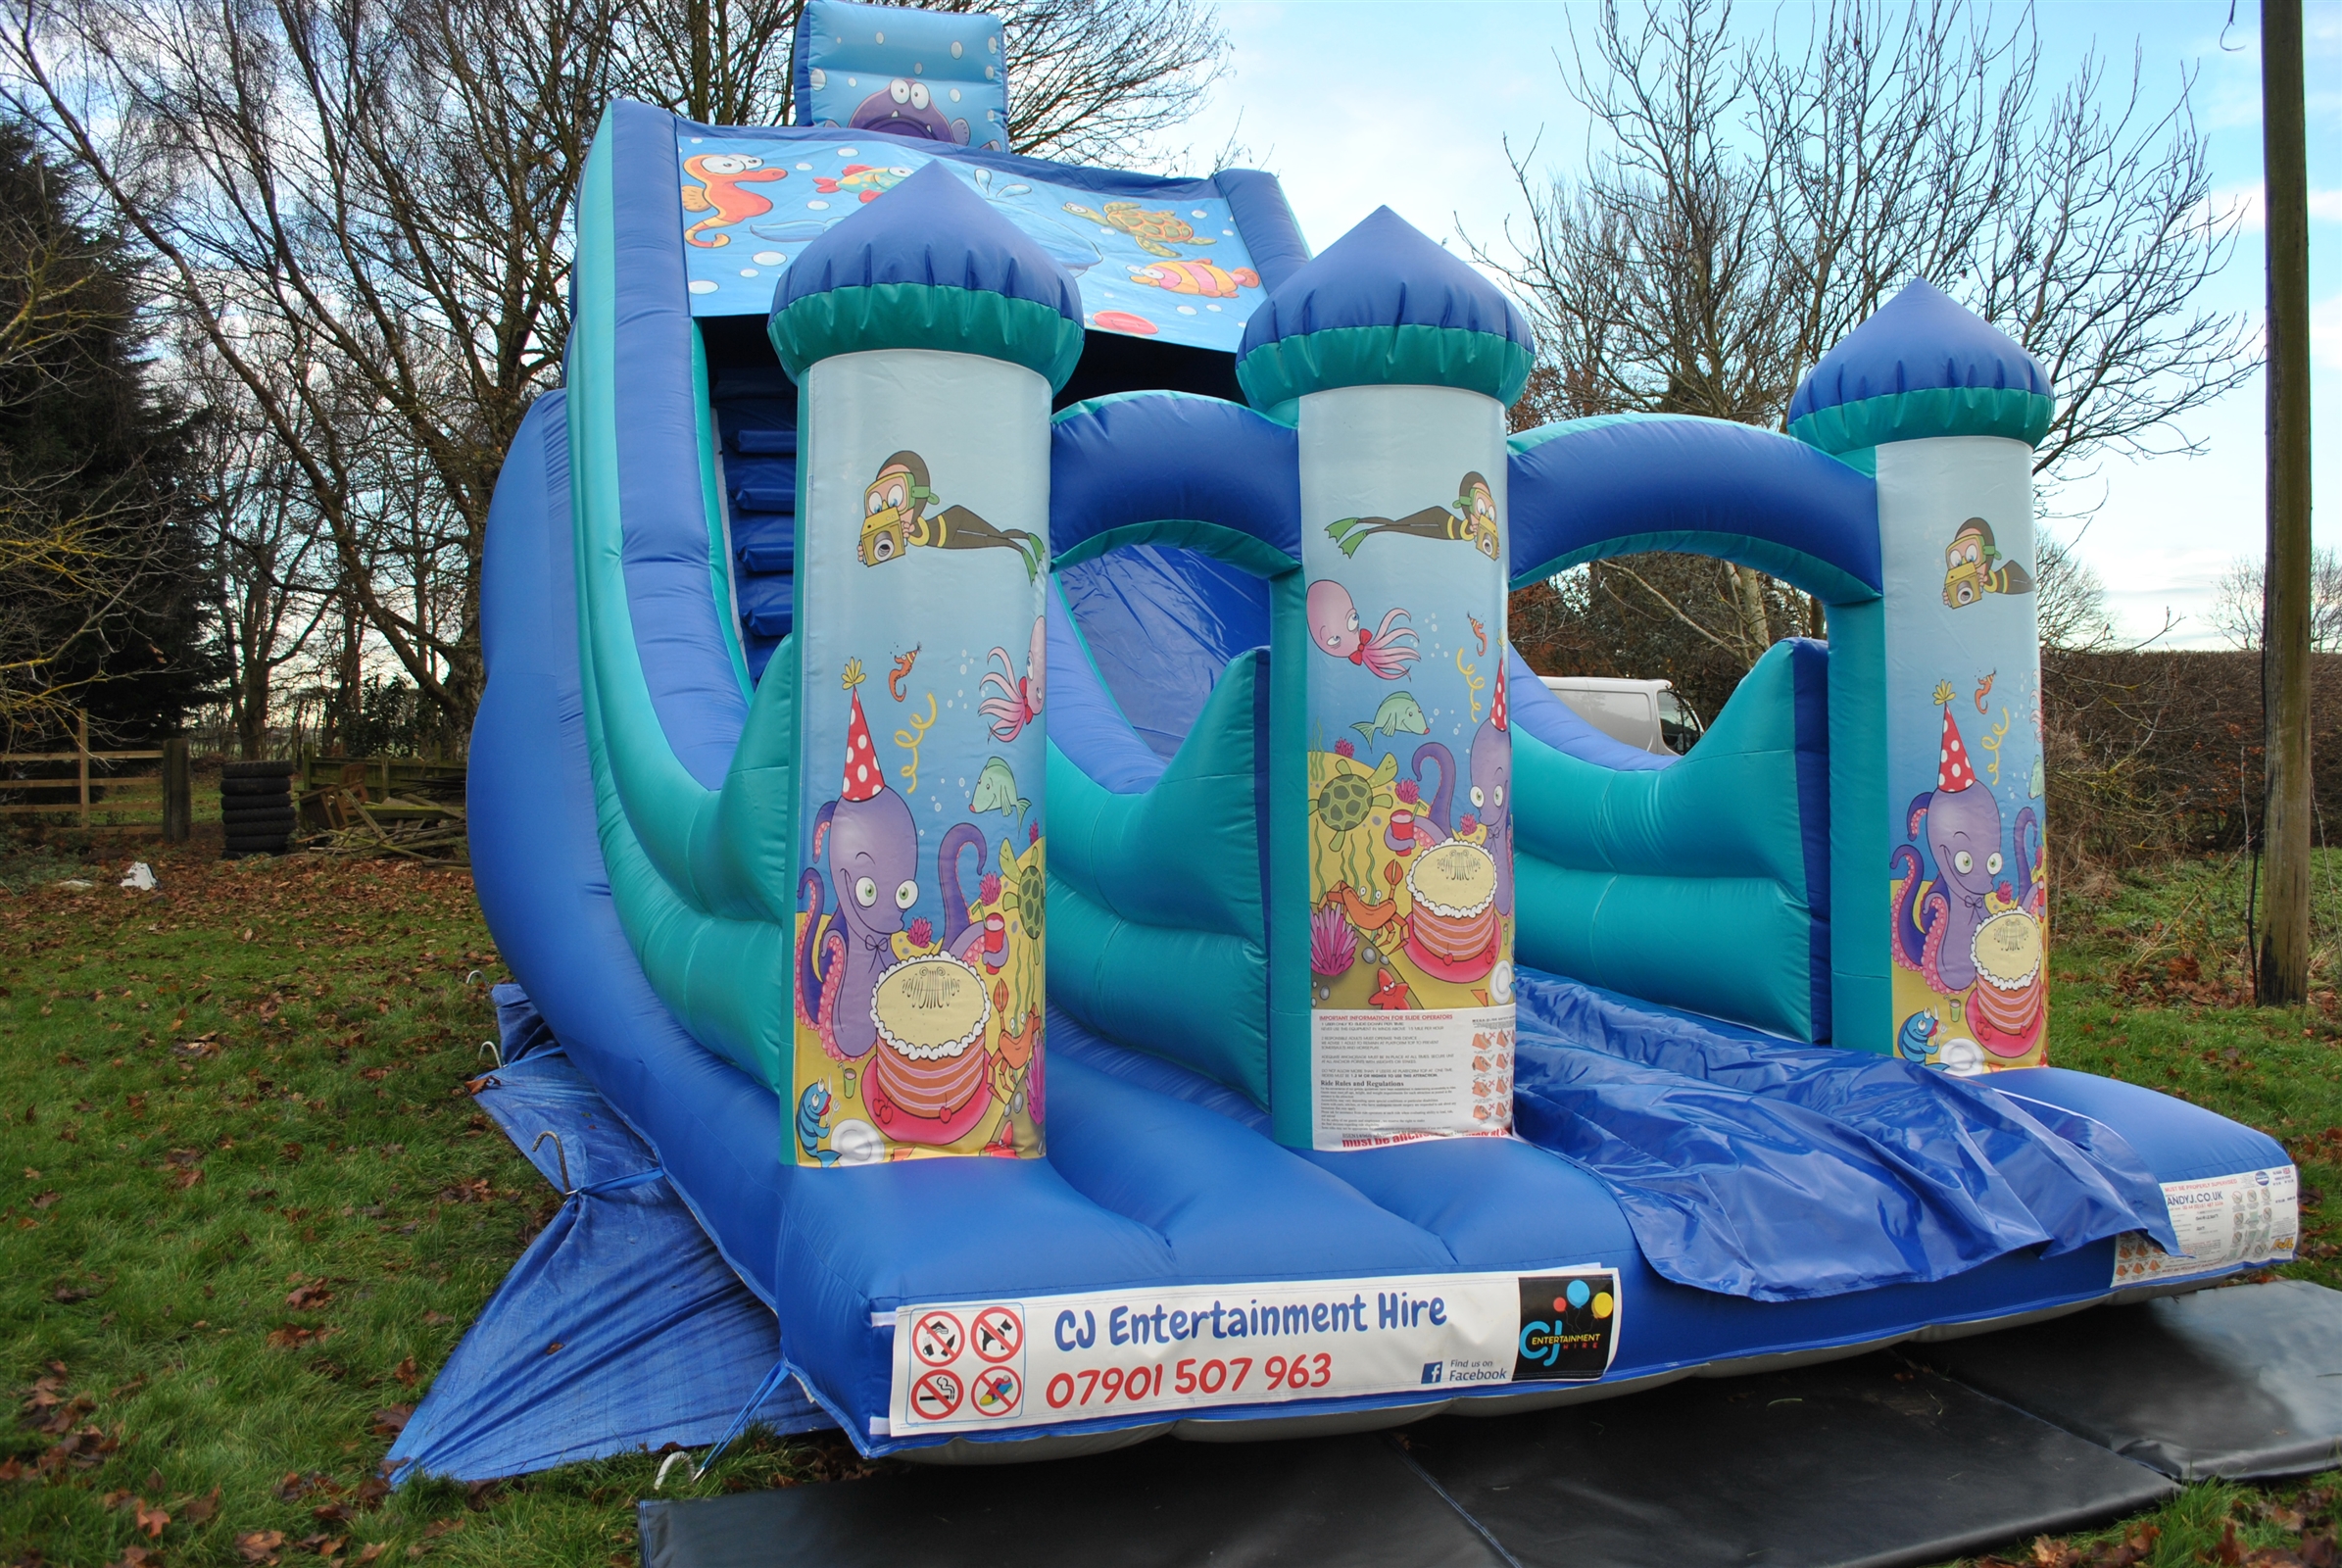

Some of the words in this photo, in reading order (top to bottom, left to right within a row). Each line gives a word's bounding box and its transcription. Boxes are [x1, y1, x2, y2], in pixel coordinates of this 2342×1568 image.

[1342, 1138, 1372, 1147] must
[2211, 1179, 2237, 1187] SUPERVISED
[1054, 1309, 1096, 1351] CJ
[1109, 1294, 1368, 1346] Entertainment
[1377, 1292, 1447, 1329] Hire
[1520, 1320, 1562, 1367] CJ
[1532, 1333, 1601, 1346] ENTERTAINMENT
[1450, 1359, 1468, 1368] Find
[1046, 1363, 1163, 1409] 07901
[1175, 1357, 1253, 1394] 507
[1264, 1352, 1332, 1391] 963
[1449, 1368, 1507, 1381] Facebook
